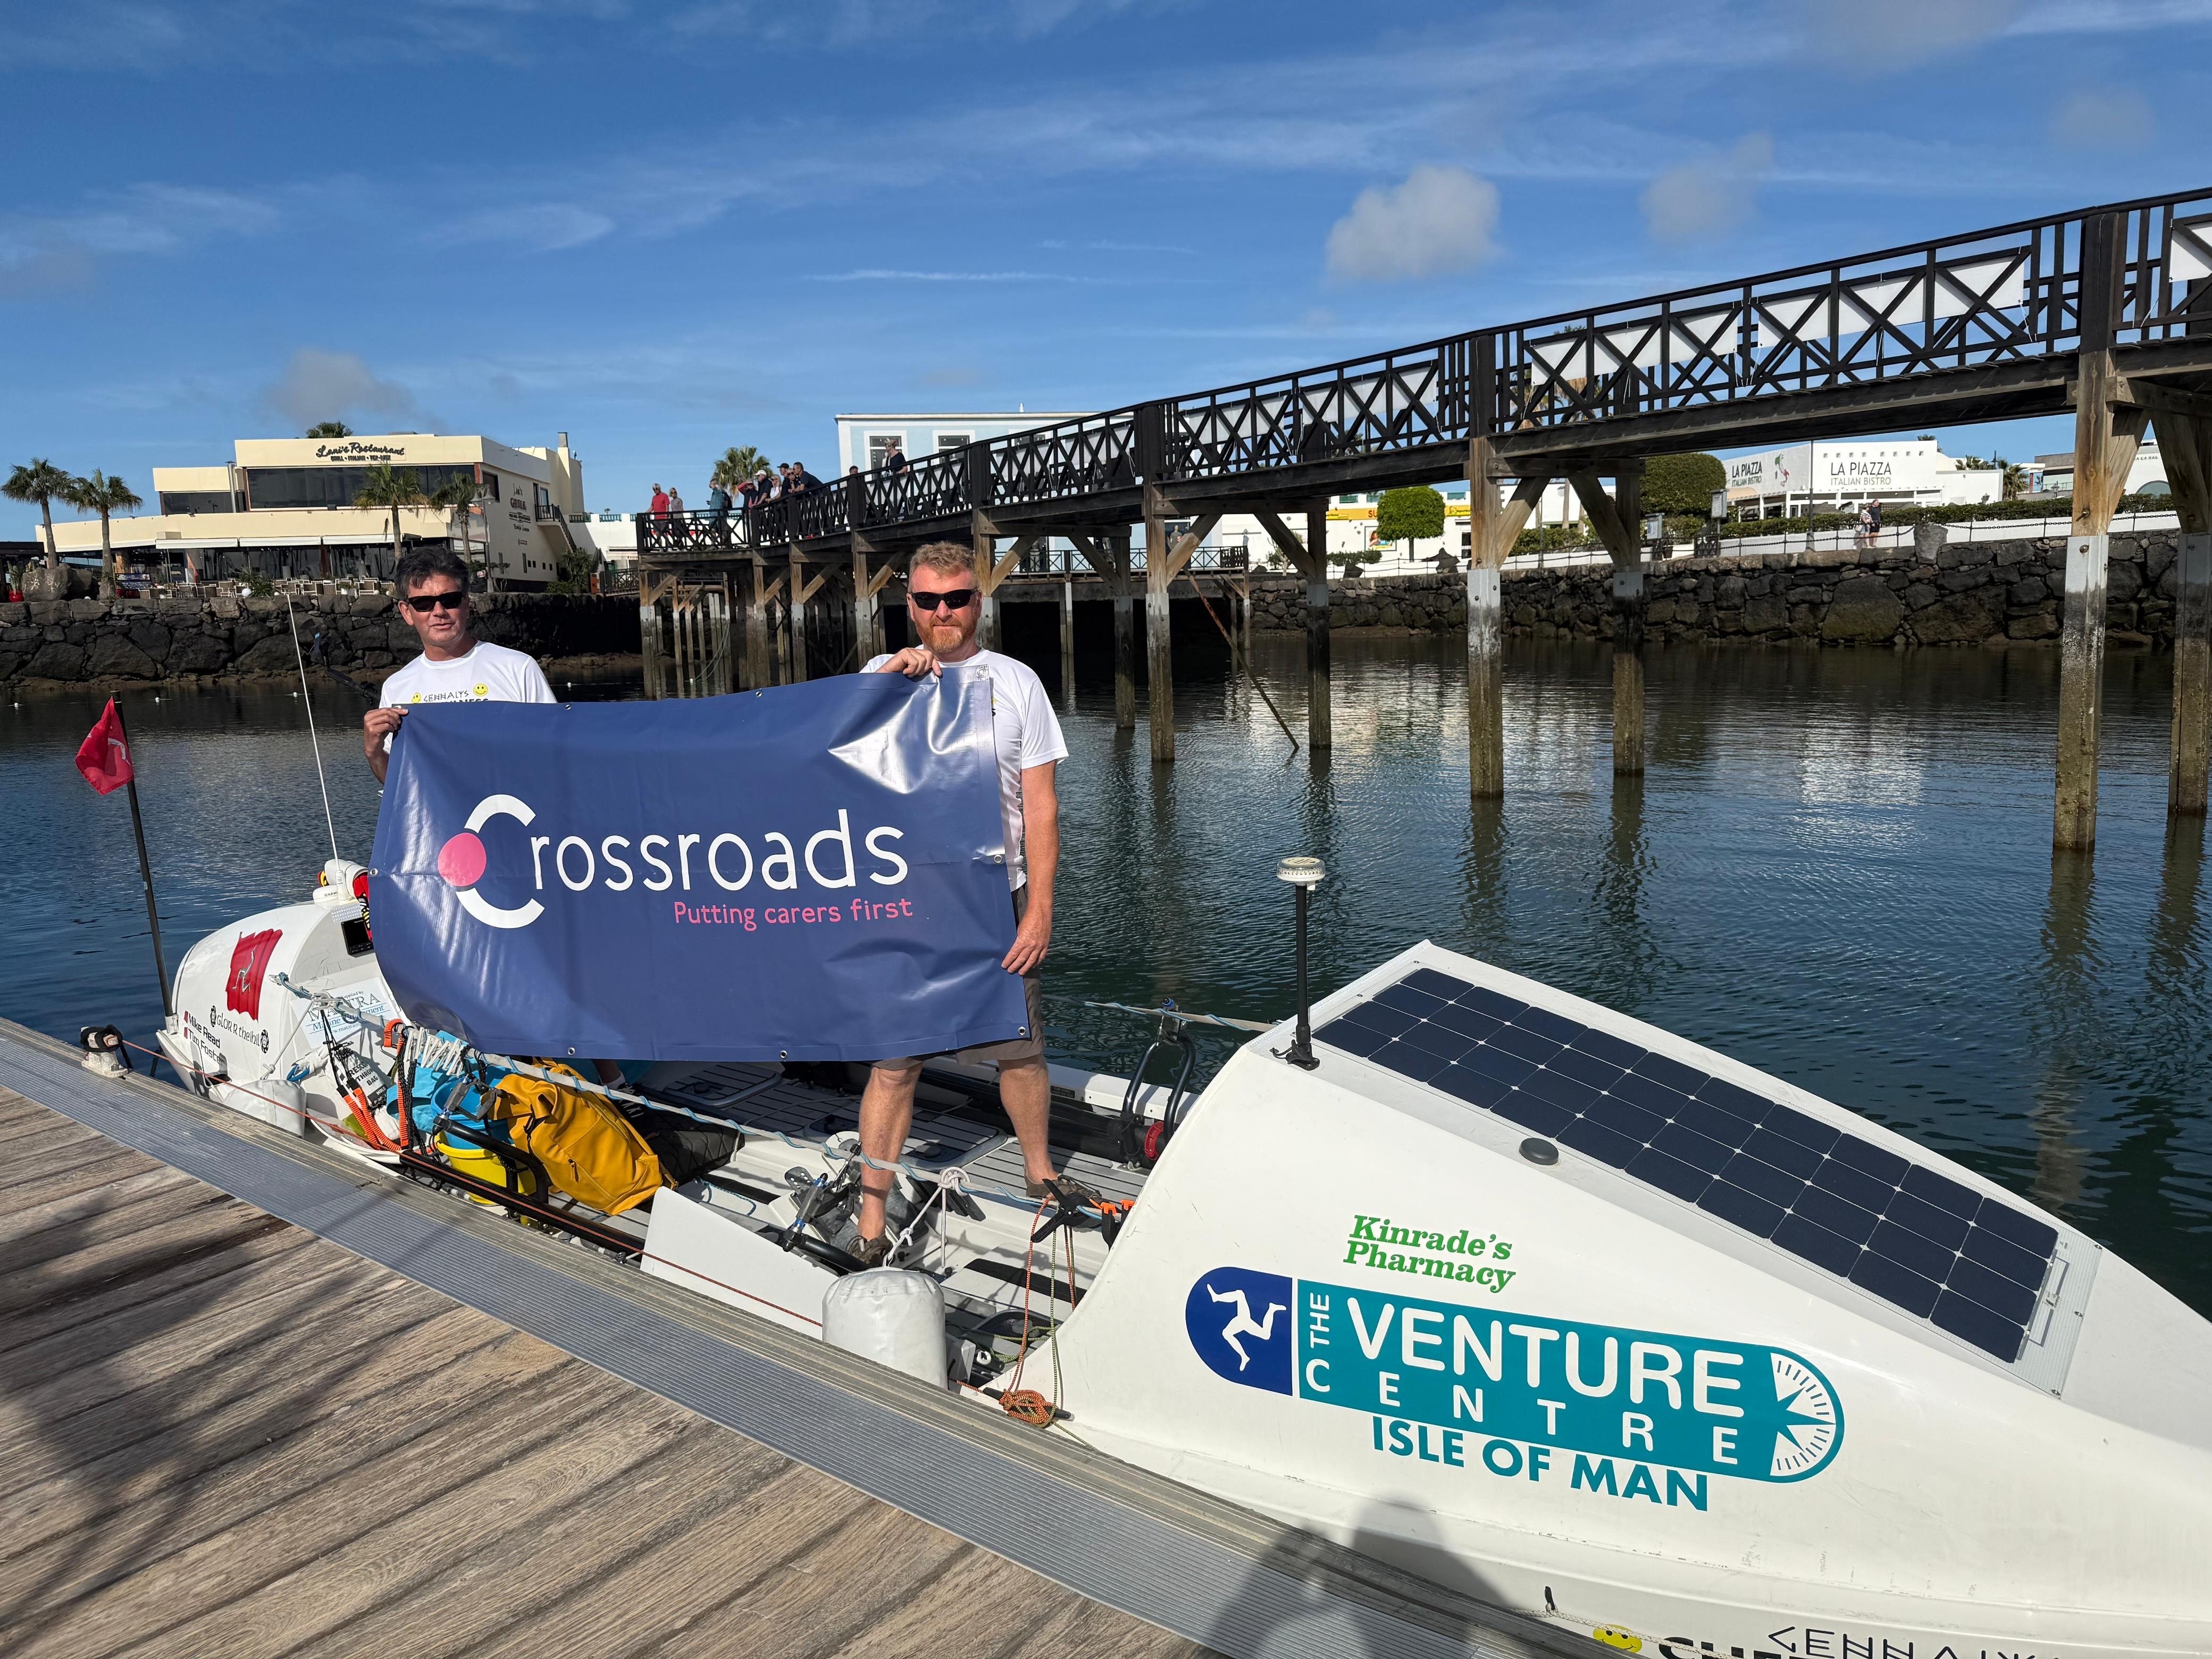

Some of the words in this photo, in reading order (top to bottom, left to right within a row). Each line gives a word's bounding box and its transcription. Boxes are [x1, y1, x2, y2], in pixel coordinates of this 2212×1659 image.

[349, 442, 405, 455] Restaurant
[1732, 465, 1739, 478] LA
[1741, 461, 1762, 477] PIAZZA
[1732, 477, 1747, 487] ITALIAN
[1748, 476, 1762, 485] BISTRO
[1831, 462, 1845, 475] LA
[1850, 462, 1891, 475] PIAZZA
[438, 794, 908, 929] Crossroads
[674, 901, 757, 931] Putting
[764, 904, 841, 923] carers
[850, 898, 913, 921] first
[188, 1028, 200, 1045] Tim
[200, 1040, 226, 1067] Foster
[189, 1013, 202, 1034] Mike
[203, 1026, 220, 1049] Read
[356, 1069, 373, 1082] THRO
[366, 1075, 379, 1086] BAG
[1348, 1214, 1512, 1260] Kinrade's
[1343, 1240, 1516, 1293] Pharmacy
[1310, 1292, 1330, 1348] THE
[1347, 1297, 1745, 1418] VENTURE
[1306, 1359, 1738, 1465] CENTRE
[1372, 1416, 1464, 1468] ISLE
[1482, 1439, 1551, 1482] OF
[1570, 1454, 1708, 1512] MAN
